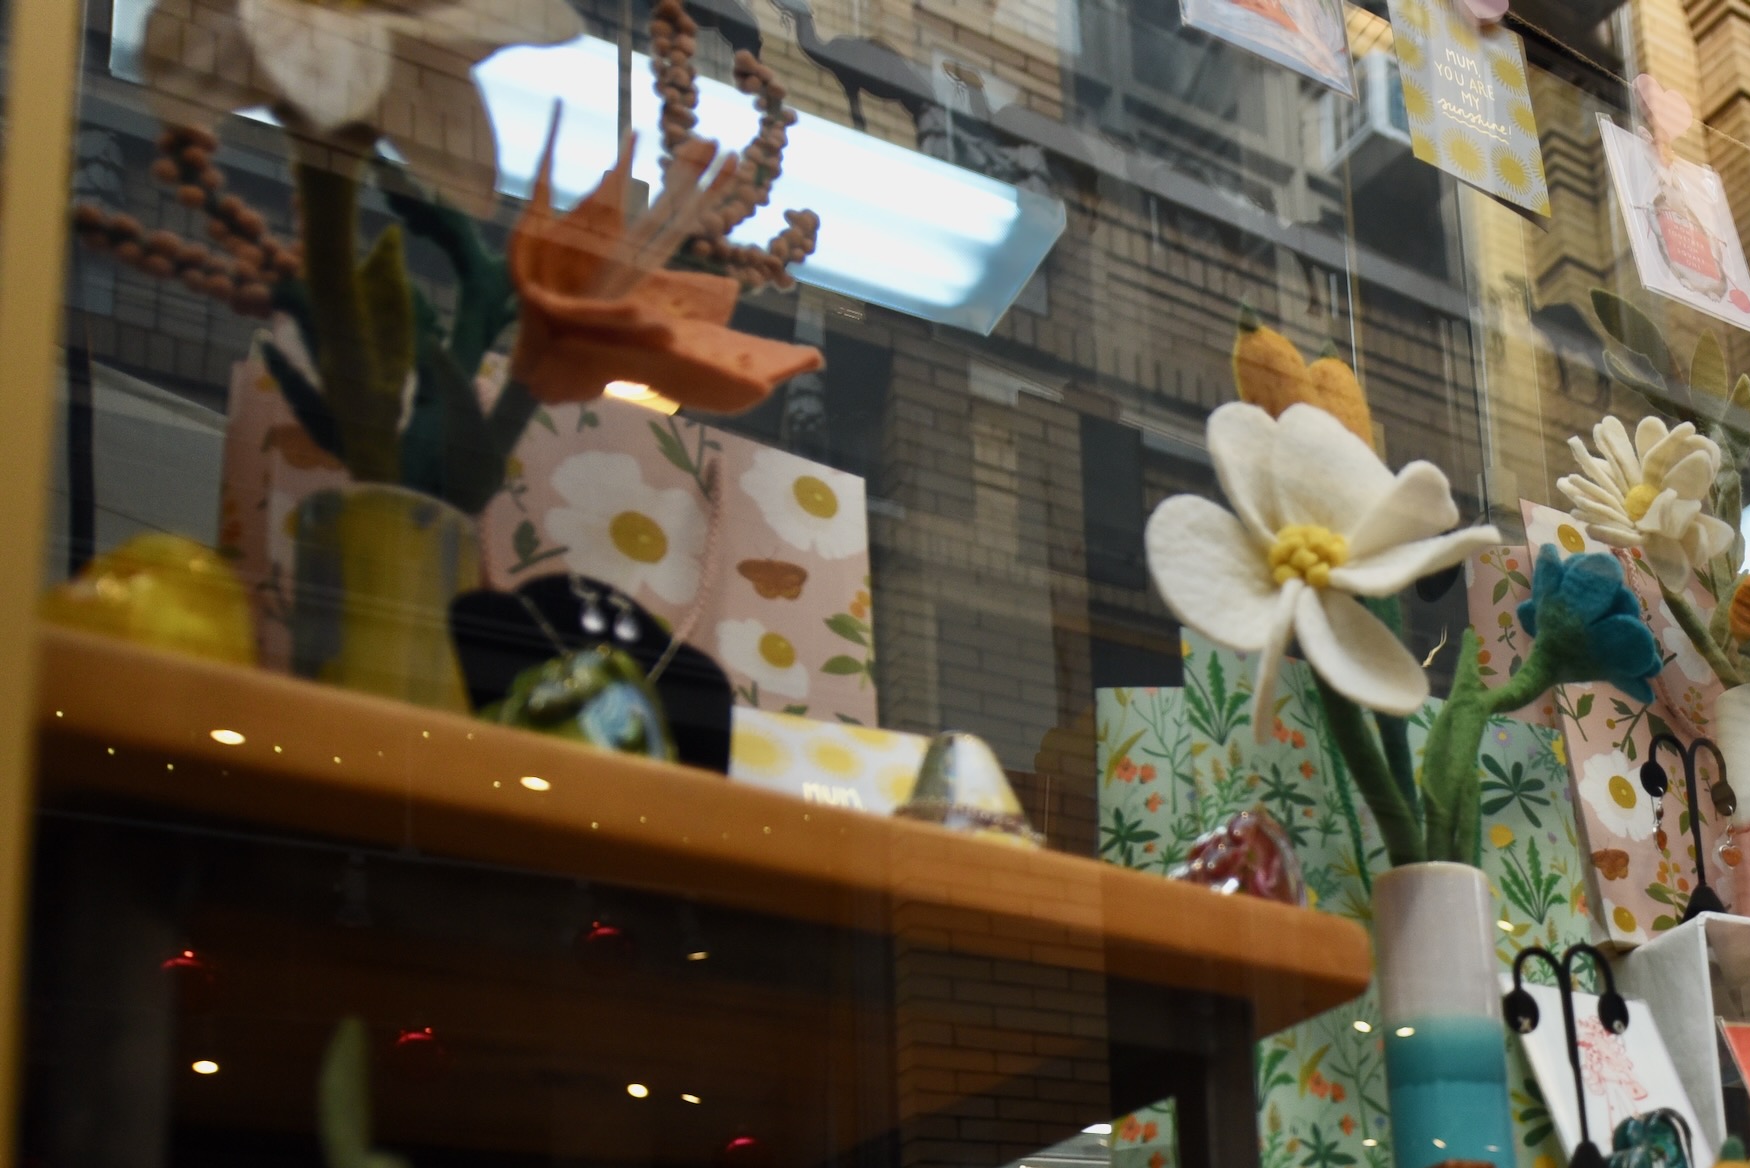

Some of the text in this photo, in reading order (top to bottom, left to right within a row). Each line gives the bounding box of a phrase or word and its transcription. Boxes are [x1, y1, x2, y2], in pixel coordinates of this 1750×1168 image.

[1434, 60, 1495, 101] YOU ARE
[1446, 47, 1481, 78] MUM,
[1438, 98, 1512, 139] sunshine!
[1461, 90, 1479, 111] MY
